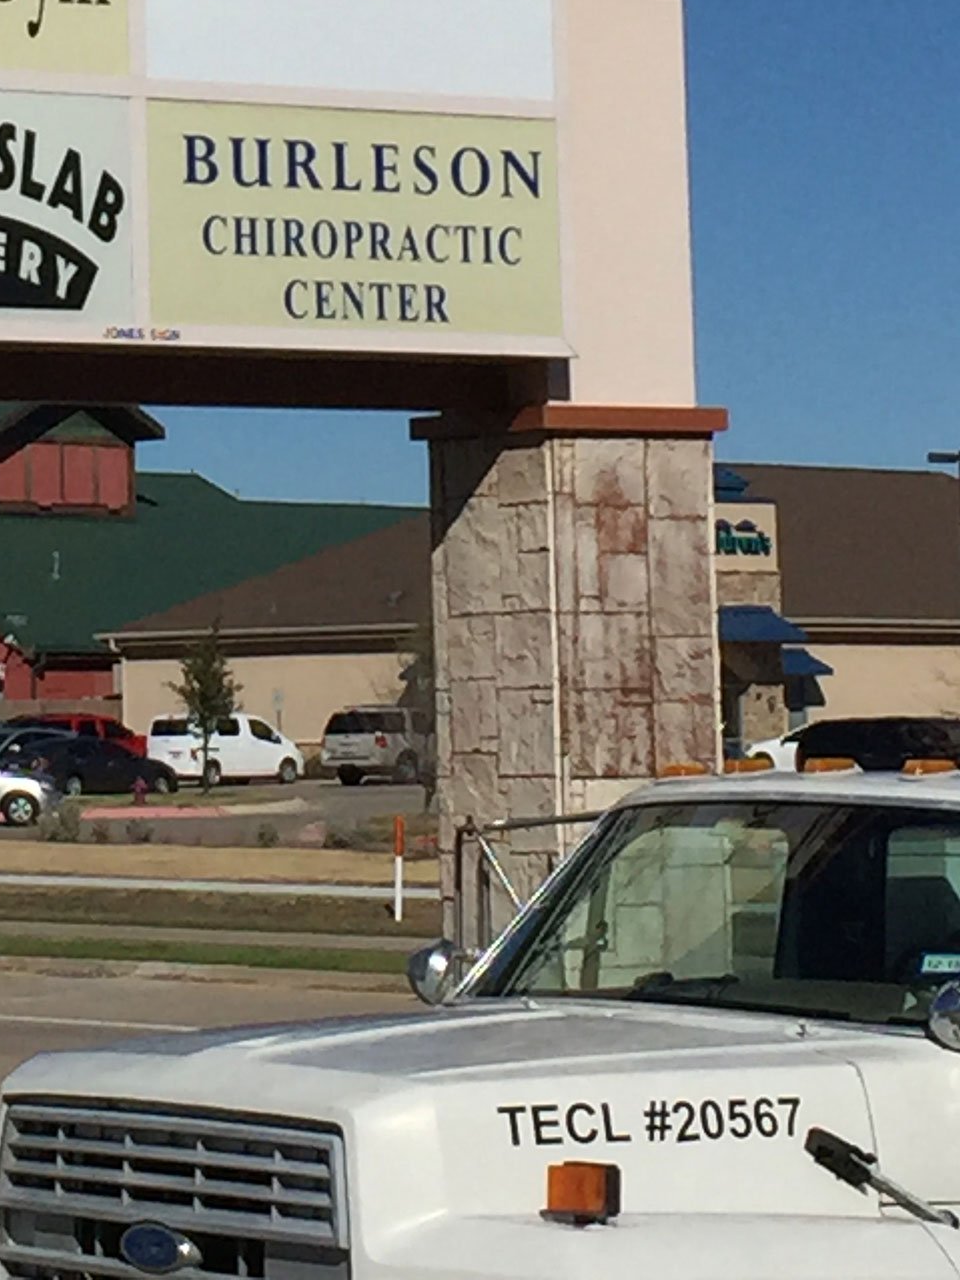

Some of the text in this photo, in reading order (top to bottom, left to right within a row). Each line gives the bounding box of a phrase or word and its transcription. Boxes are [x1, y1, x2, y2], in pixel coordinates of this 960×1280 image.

[182, 134, 542, 199] BURLESON
[202, 215, 522, 266] CHIROPRACTIC
[283, 279, 450, 323] CENTER
[102, 326, 145, 341] JONES
[497, 1096, 801, 1146] TECL #20567
